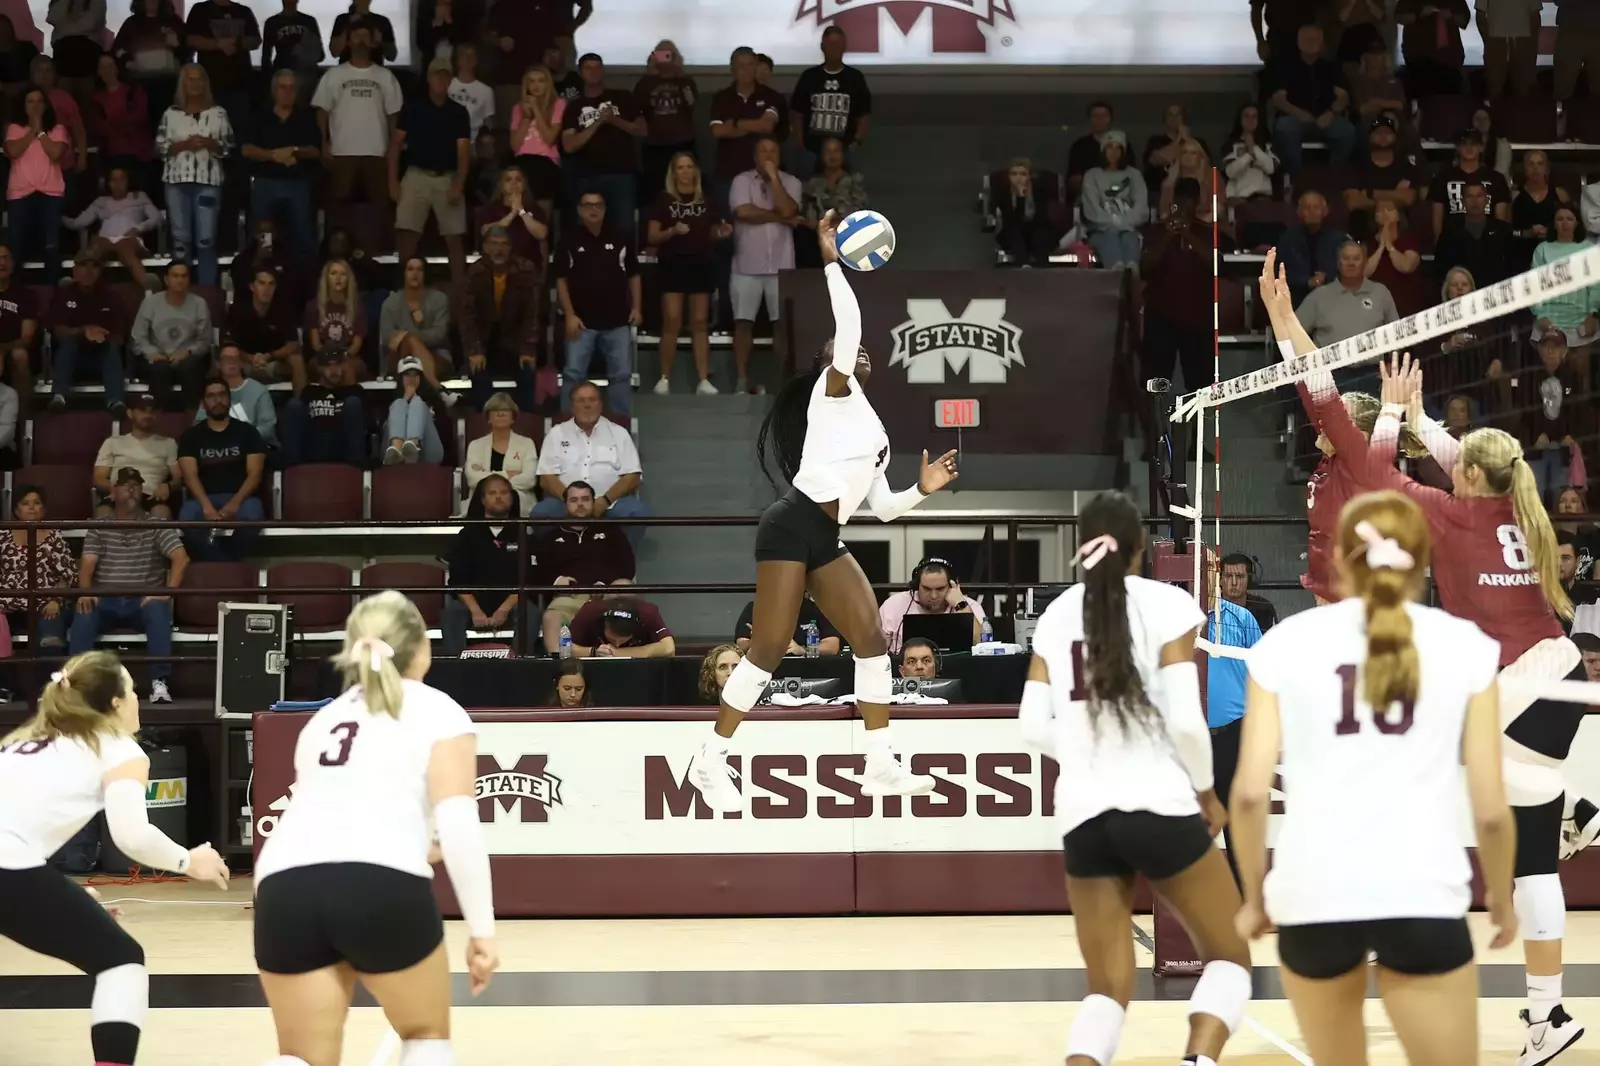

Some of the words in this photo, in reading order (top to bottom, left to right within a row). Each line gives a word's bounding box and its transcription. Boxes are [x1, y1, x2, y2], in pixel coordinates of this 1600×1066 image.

[915, 324, 998, 352] STATE
[942, 400, 975, 425] EXIT
[1496, 524, 1535, 570] 8
[1478, 573, 1540, 586] ARKANS
[319, 721, 360, 767] 3
[475, 775, 543, 799] STATE
[644, 752, 1061, 820] MSSSSI
